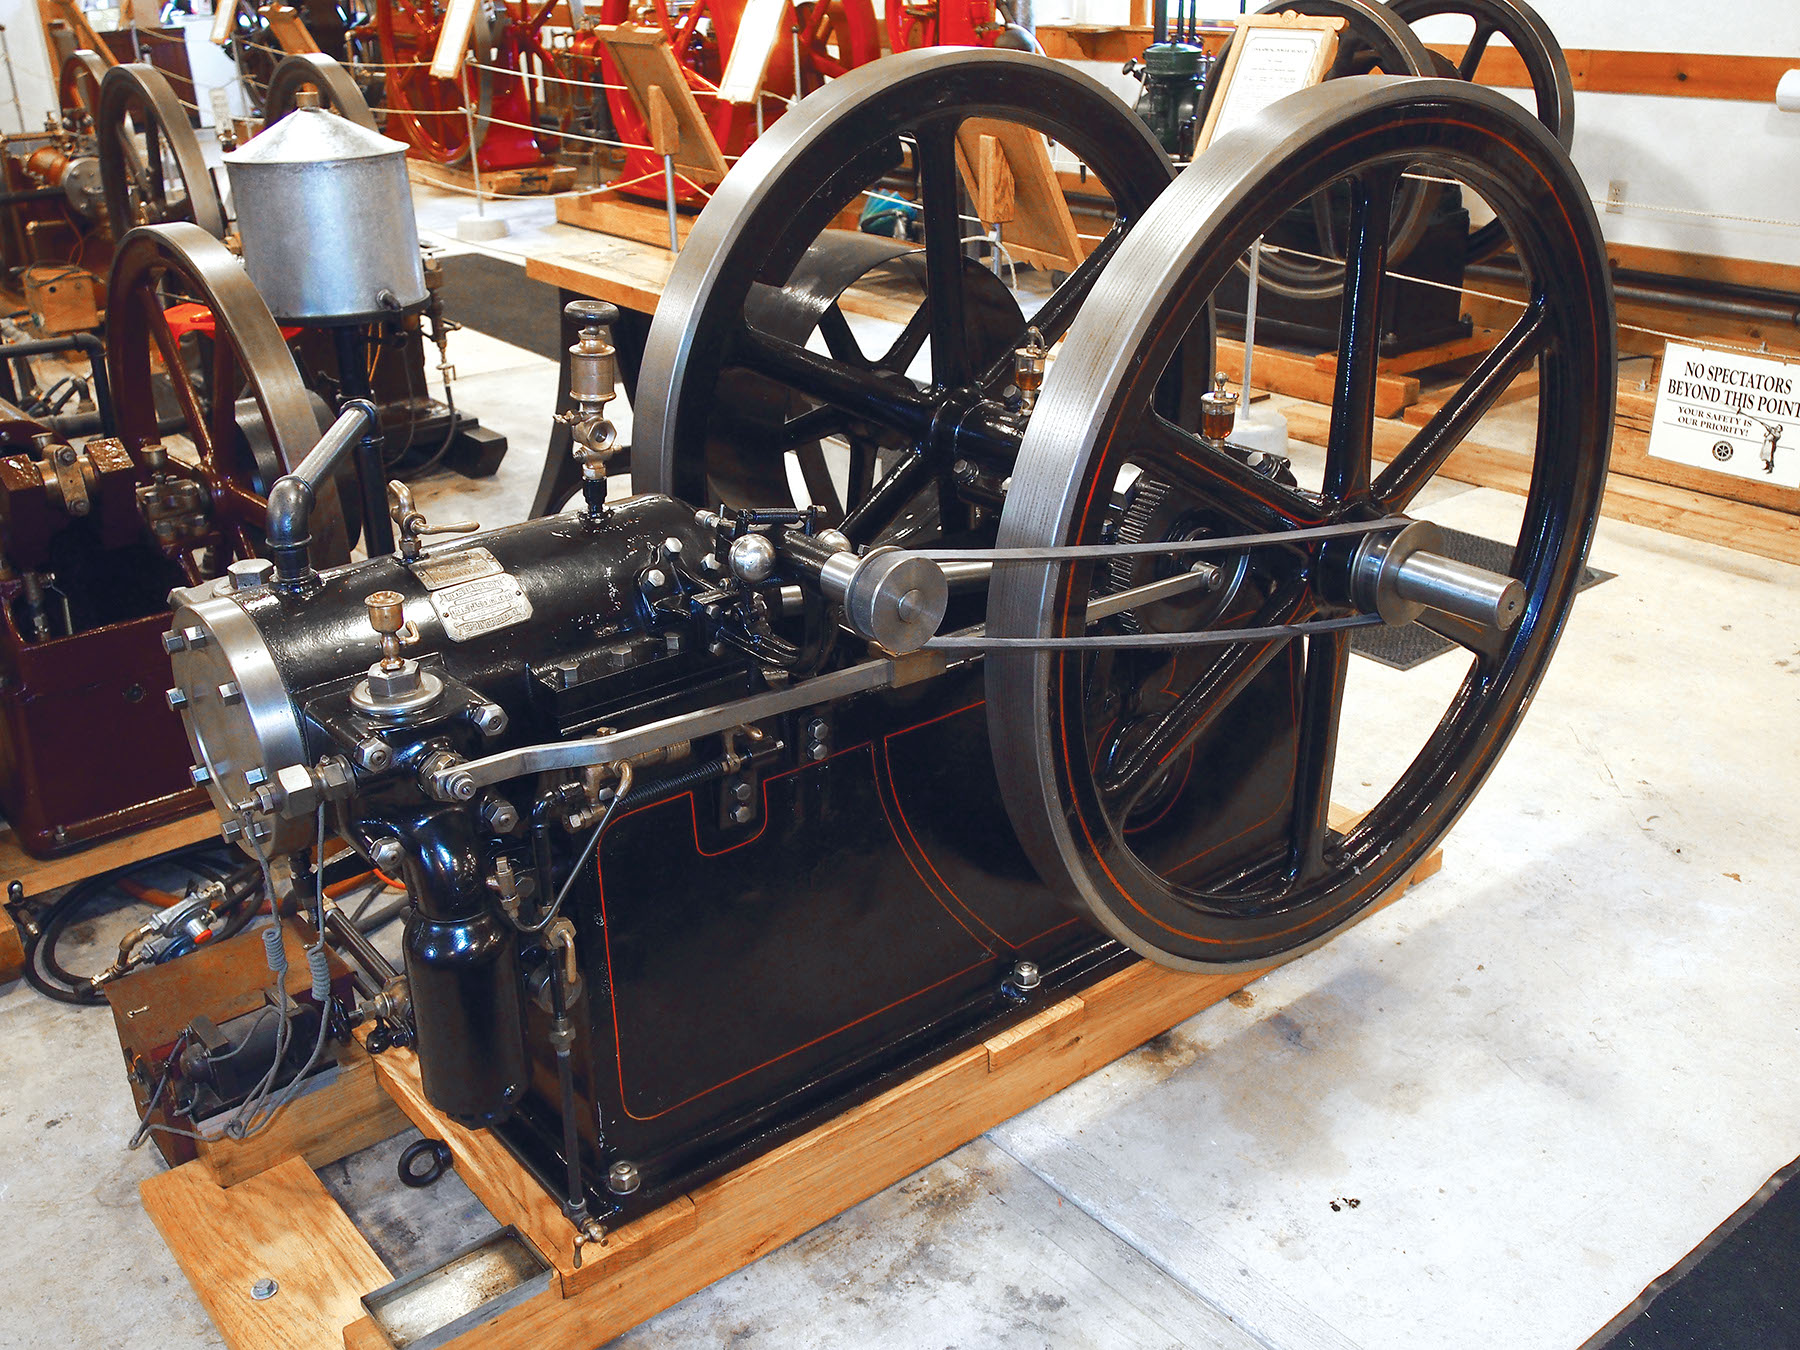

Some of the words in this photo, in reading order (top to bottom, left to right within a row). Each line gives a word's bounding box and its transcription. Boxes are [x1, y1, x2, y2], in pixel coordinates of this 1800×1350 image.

[1684, 361, 1705, 379] NO
[1706, 365, 1793, 395] SPECTATORS
[1668, 378, 1720, 403] BEYOND
[1723, 389, 1755, 409] THIS
[1757, 395, 1800, 418] POINT
[1677, 416, 1698, 427] OUR
[1700, 420, 1749, 437] PRIORITY!
[1678, 406, 1704, 418] YOUR
[1706, 411, 1741, 425] SAFETY
[1743, 419, 1753, 427] IS
